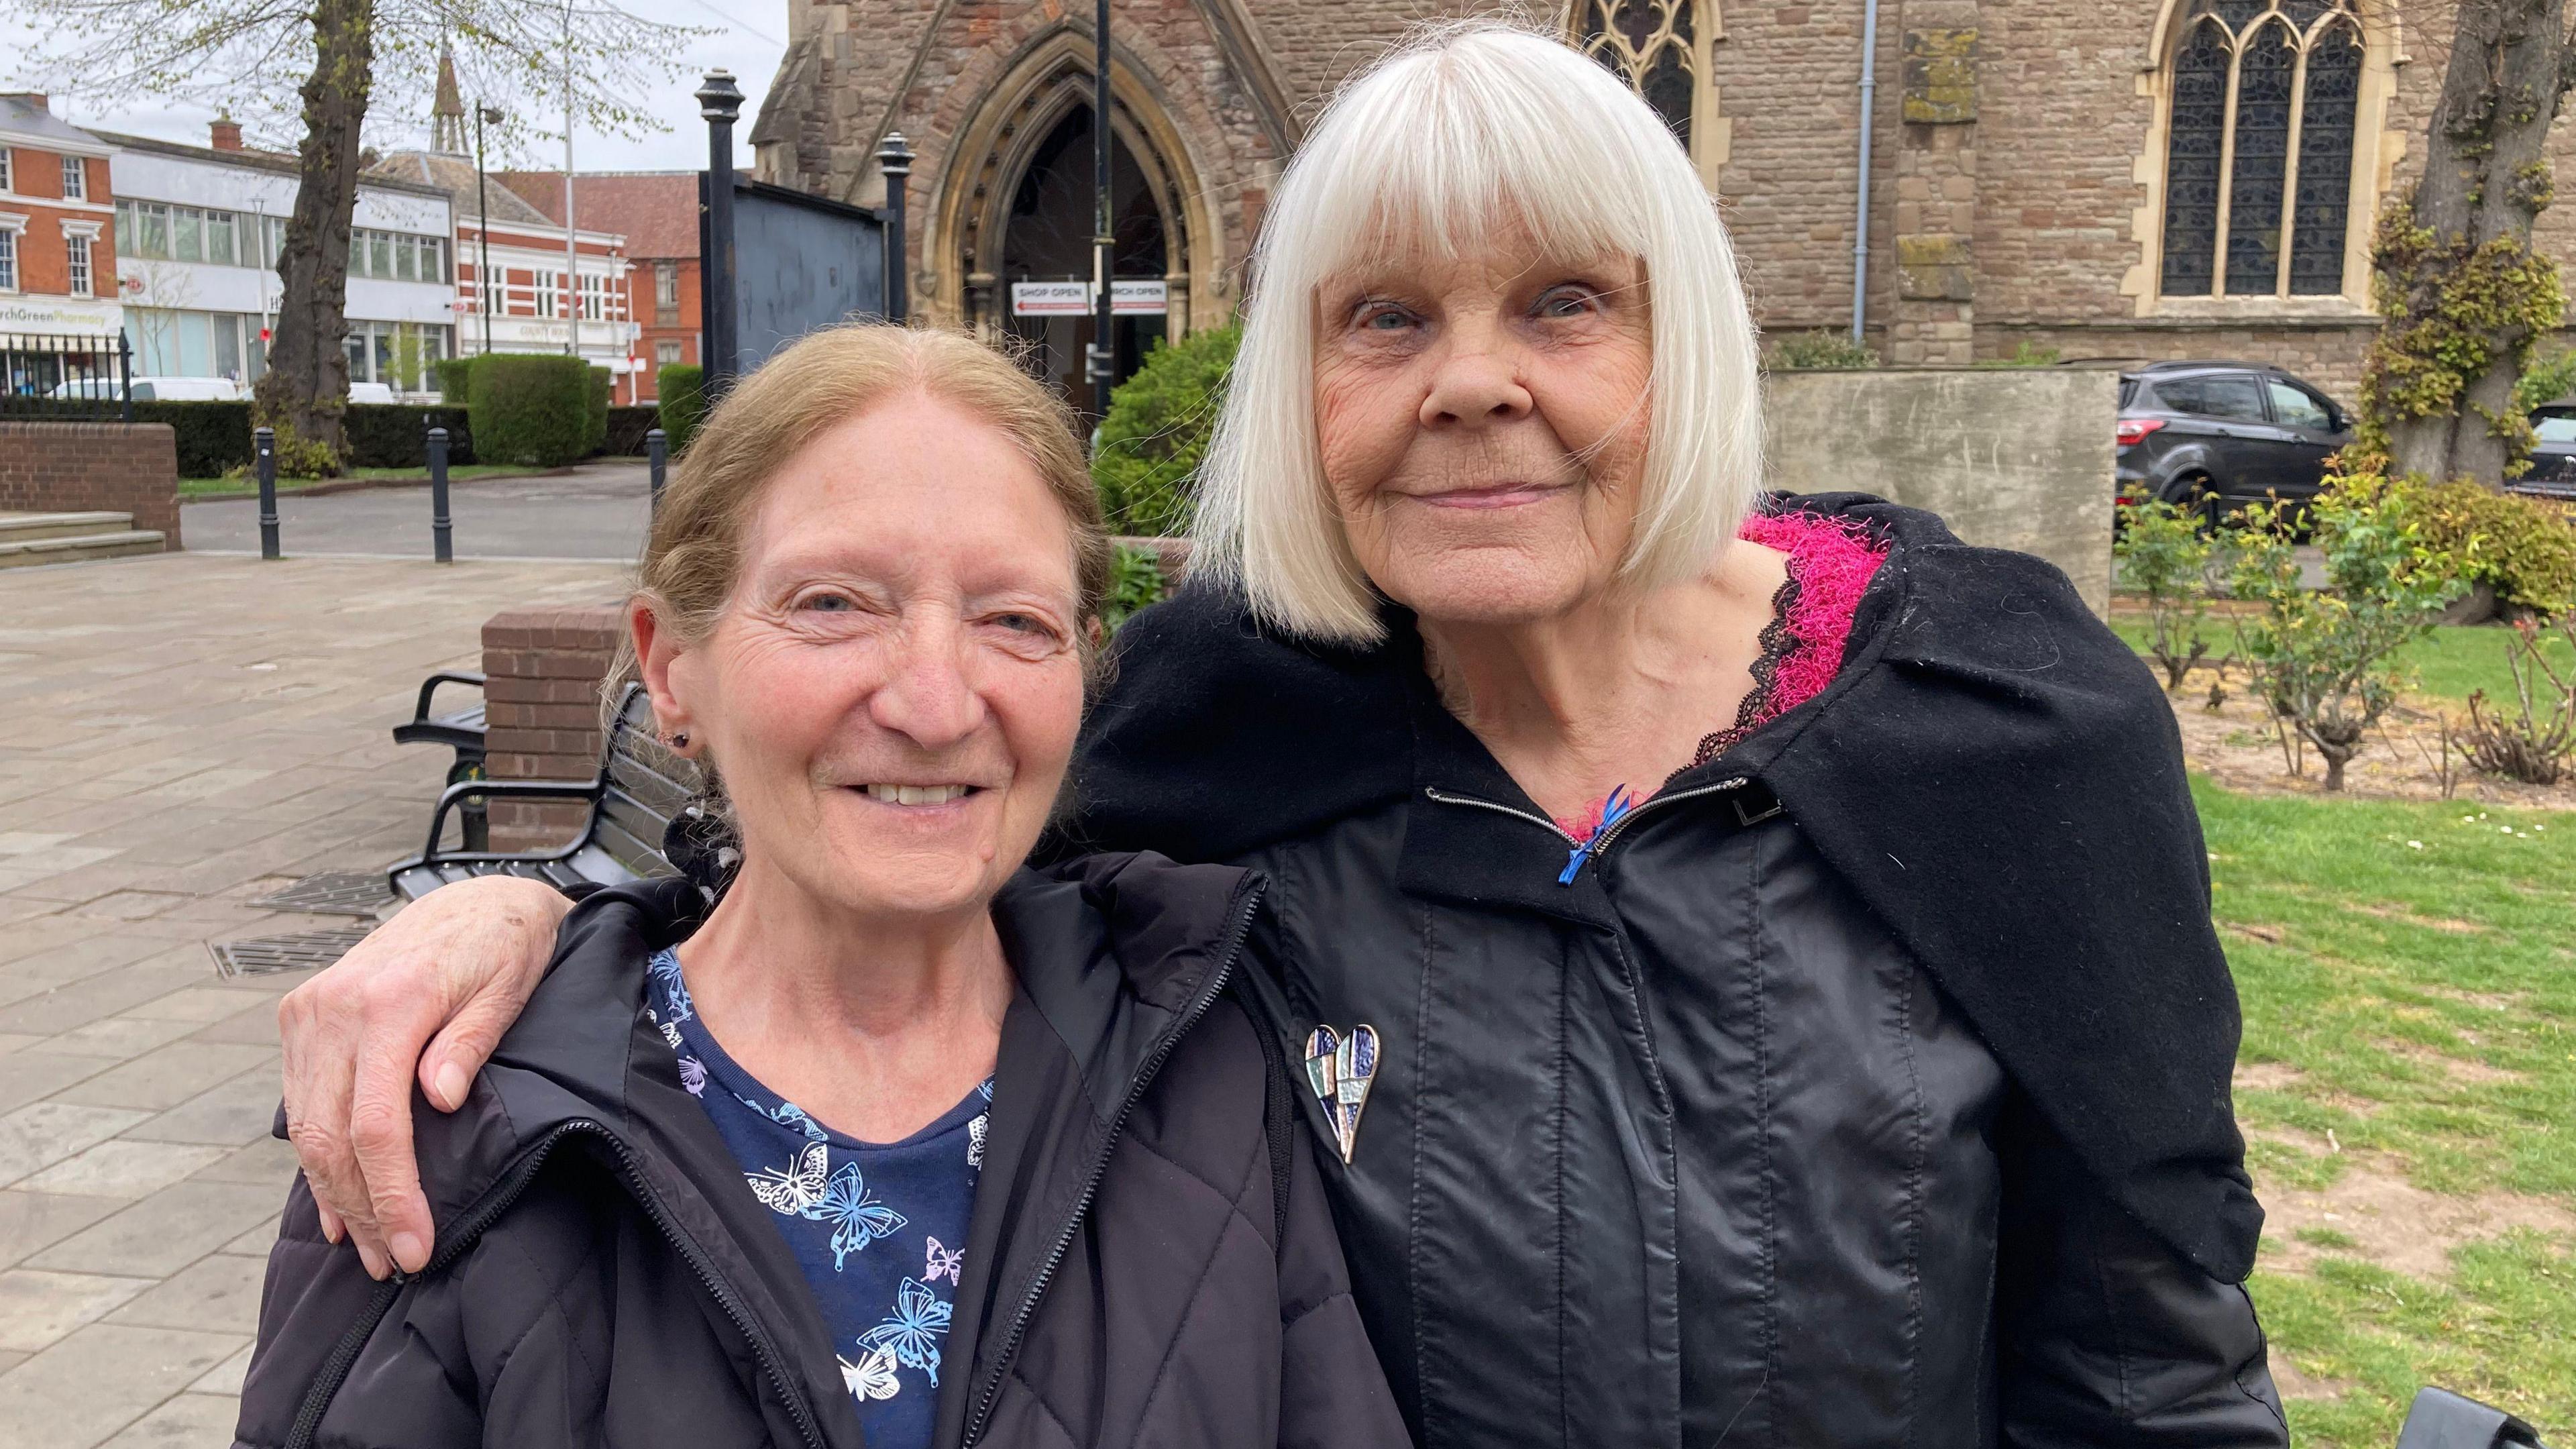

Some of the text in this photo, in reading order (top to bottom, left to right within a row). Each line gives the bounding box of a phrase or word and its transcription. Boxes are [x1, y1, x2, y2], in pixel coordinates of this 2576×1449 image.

[1020, 288, 1082, 297] SHOP OPEN
[1136, 288, 1162, 296] OPEN
